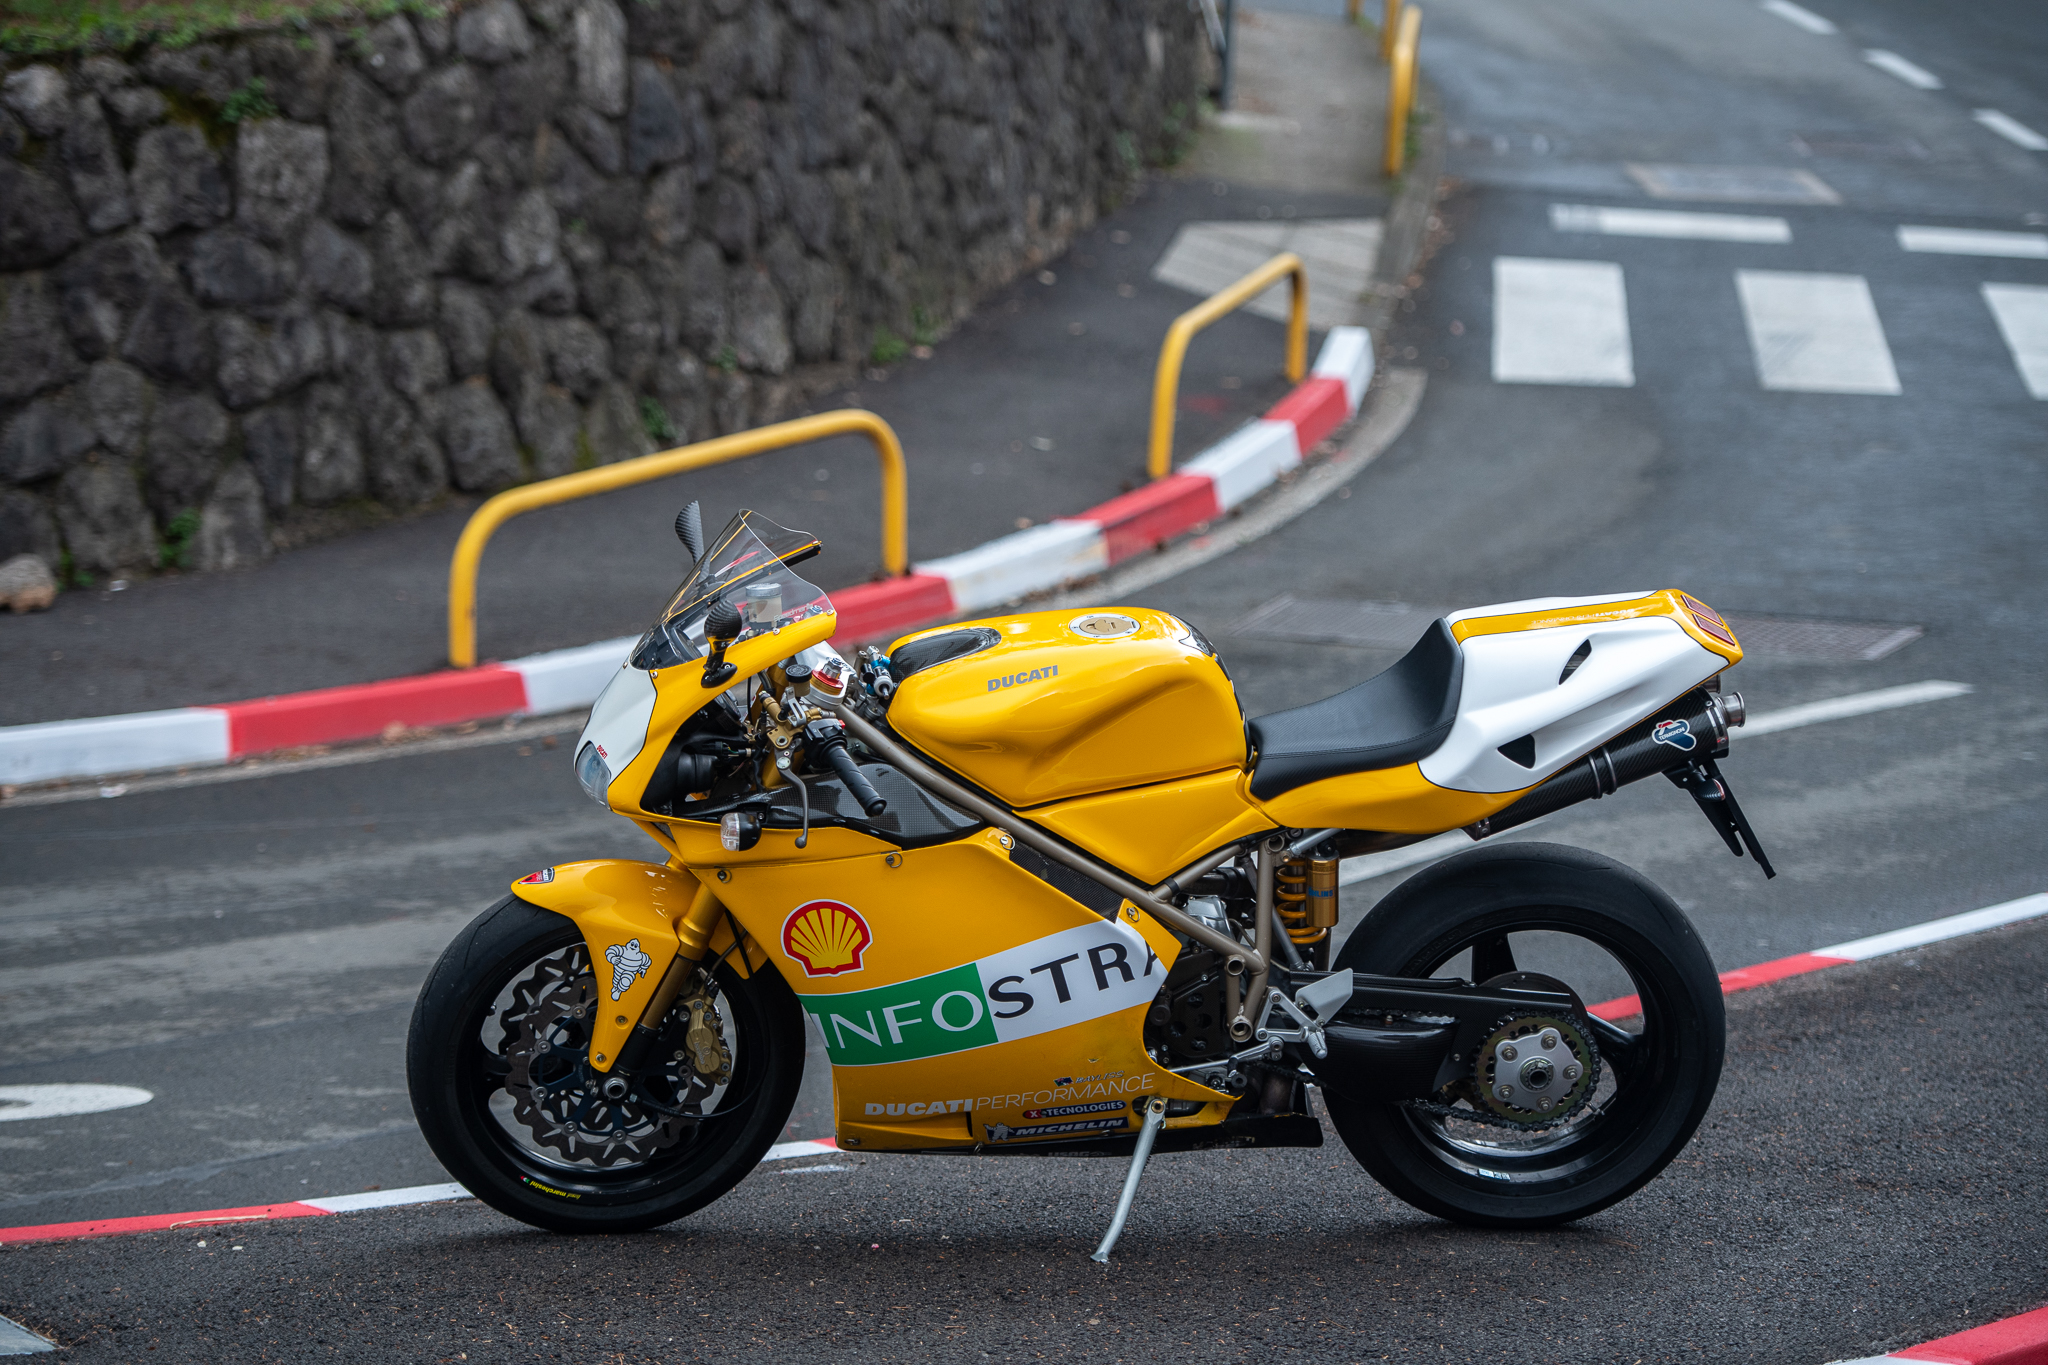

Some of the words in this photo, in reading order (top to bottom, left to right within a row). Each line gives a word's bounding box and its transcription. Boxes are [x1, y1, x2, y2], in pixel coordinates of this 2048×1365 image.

[987, 664, 1059, 693] DUCATI
[1075, 1070, 1125, 1084] BAYLISS
[864, 1098, 974, 1117] DUCATI
[976, 1072, 1156, 1111] PERFORMANCE
[1046, 1101, 1124, 1117] TECNOLOGIES
[1015, 1119, 1124, 1136] MICHELIN
[529, 1180, 567, 1197] marchesini
